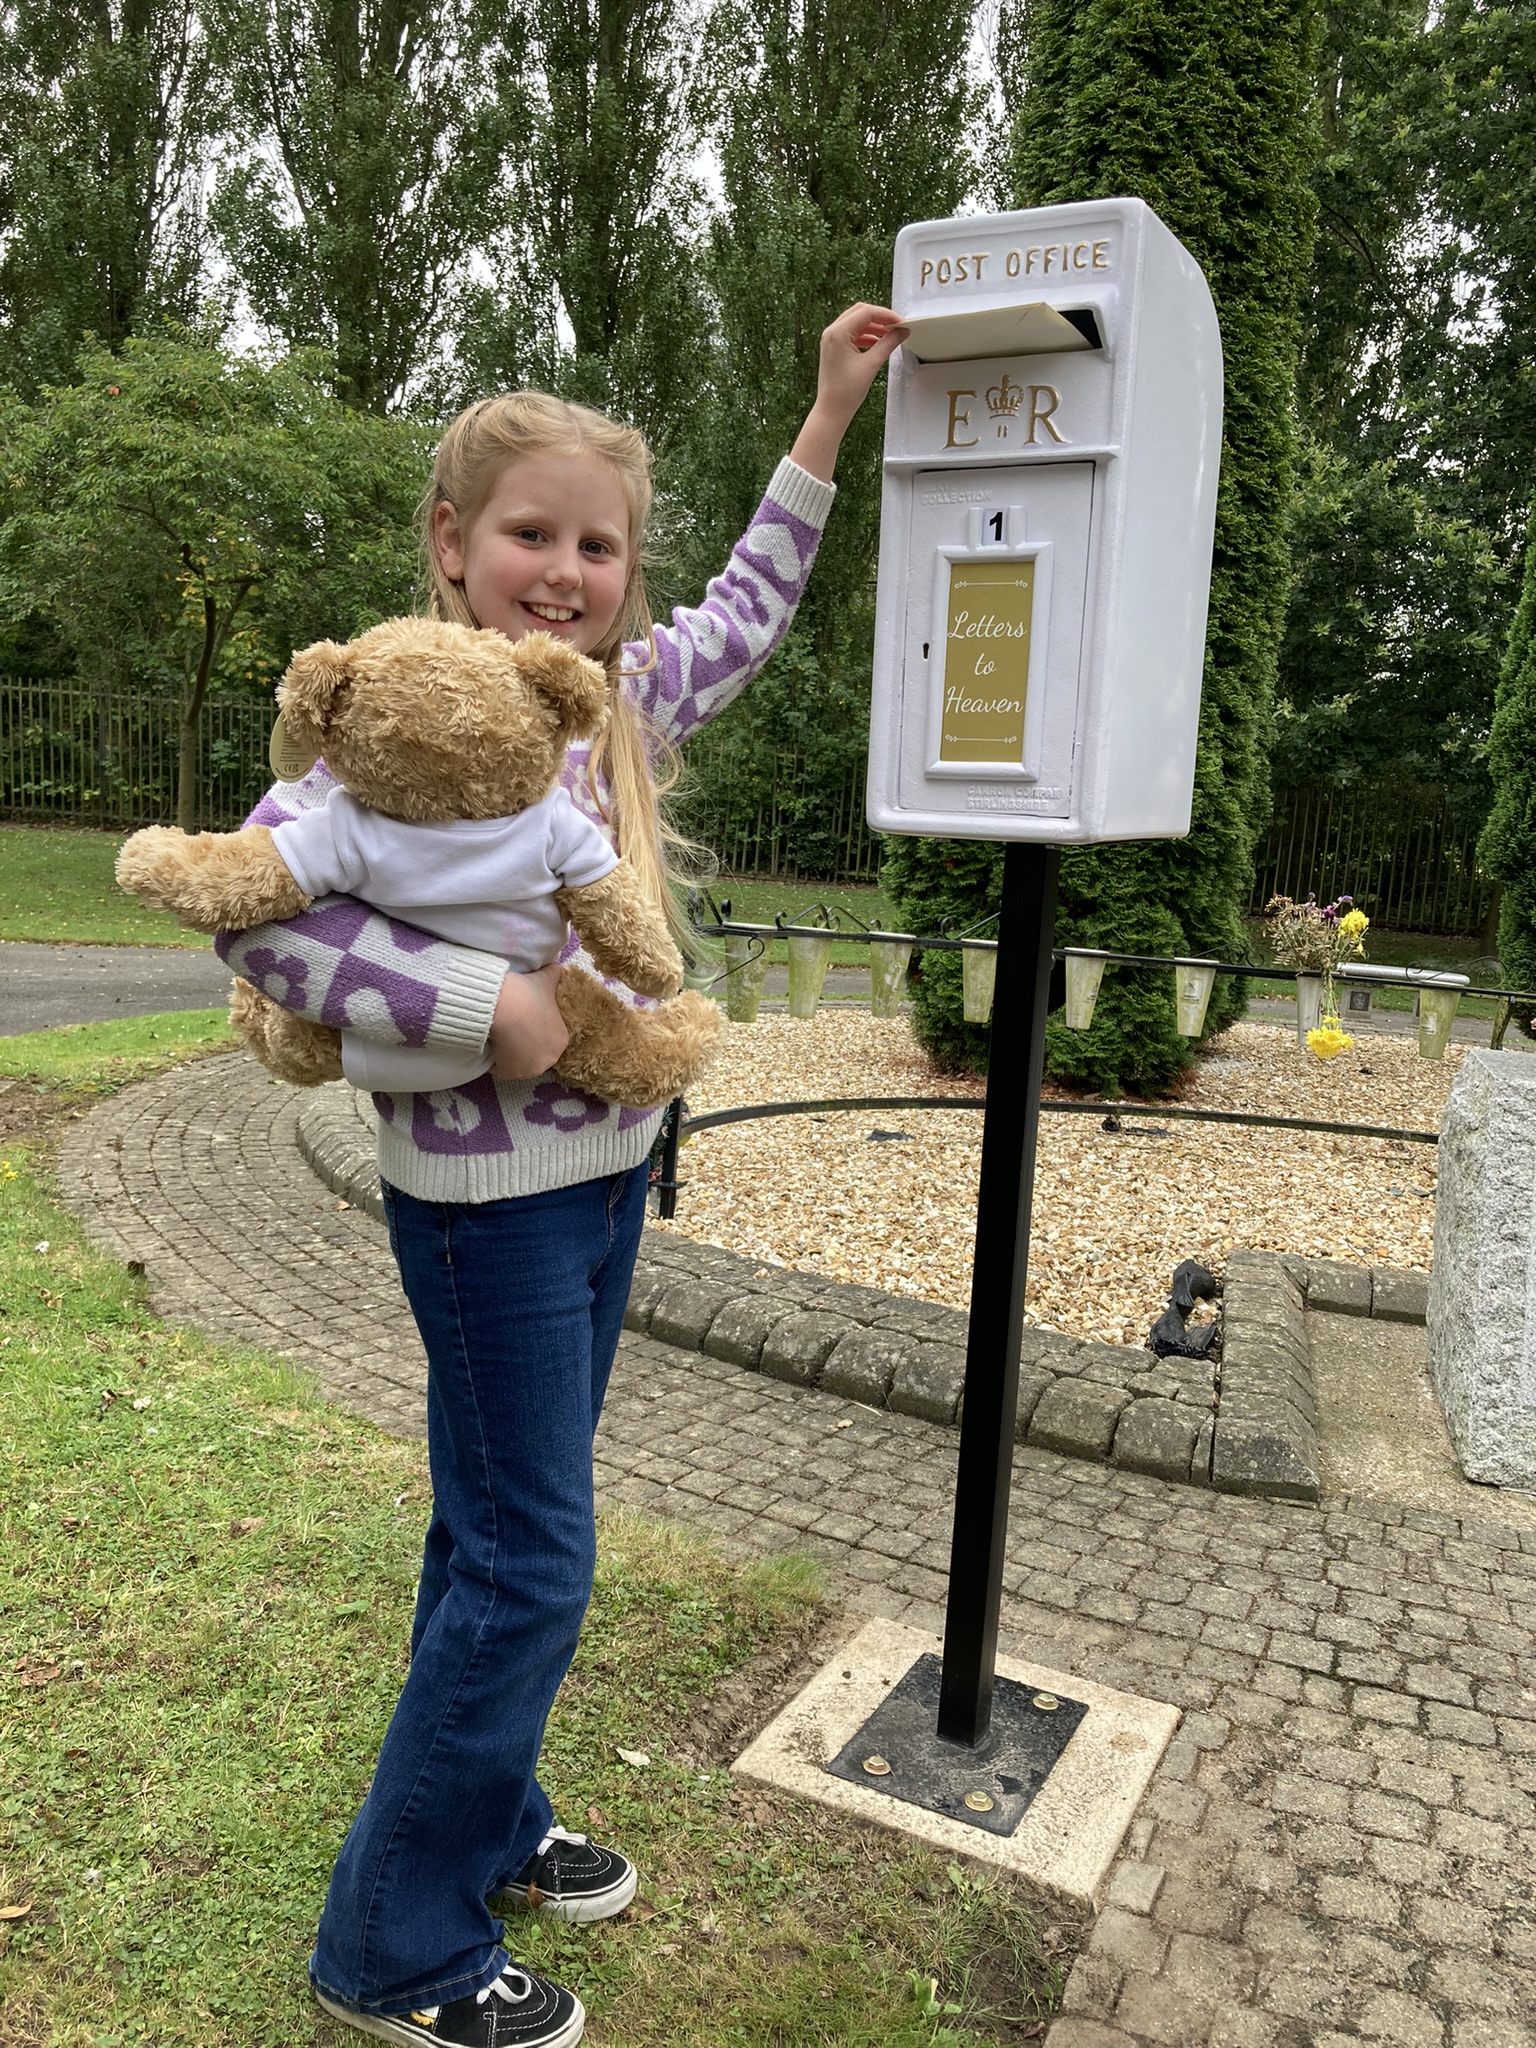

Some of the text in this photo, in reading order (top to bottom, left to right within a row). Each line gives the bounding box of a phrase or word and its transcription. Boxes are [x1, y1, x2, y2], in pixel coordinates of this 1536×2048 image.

[920, 239, 1111, 288] POST OFFICE
[920, 490, 992, 506] COLLECTION
[989, 511, 1003, 541] 1
[947, 611, 1027, 639] Letters
[974, 653, 997, 676] to
[944, 686, 1023, 714] Heaven
